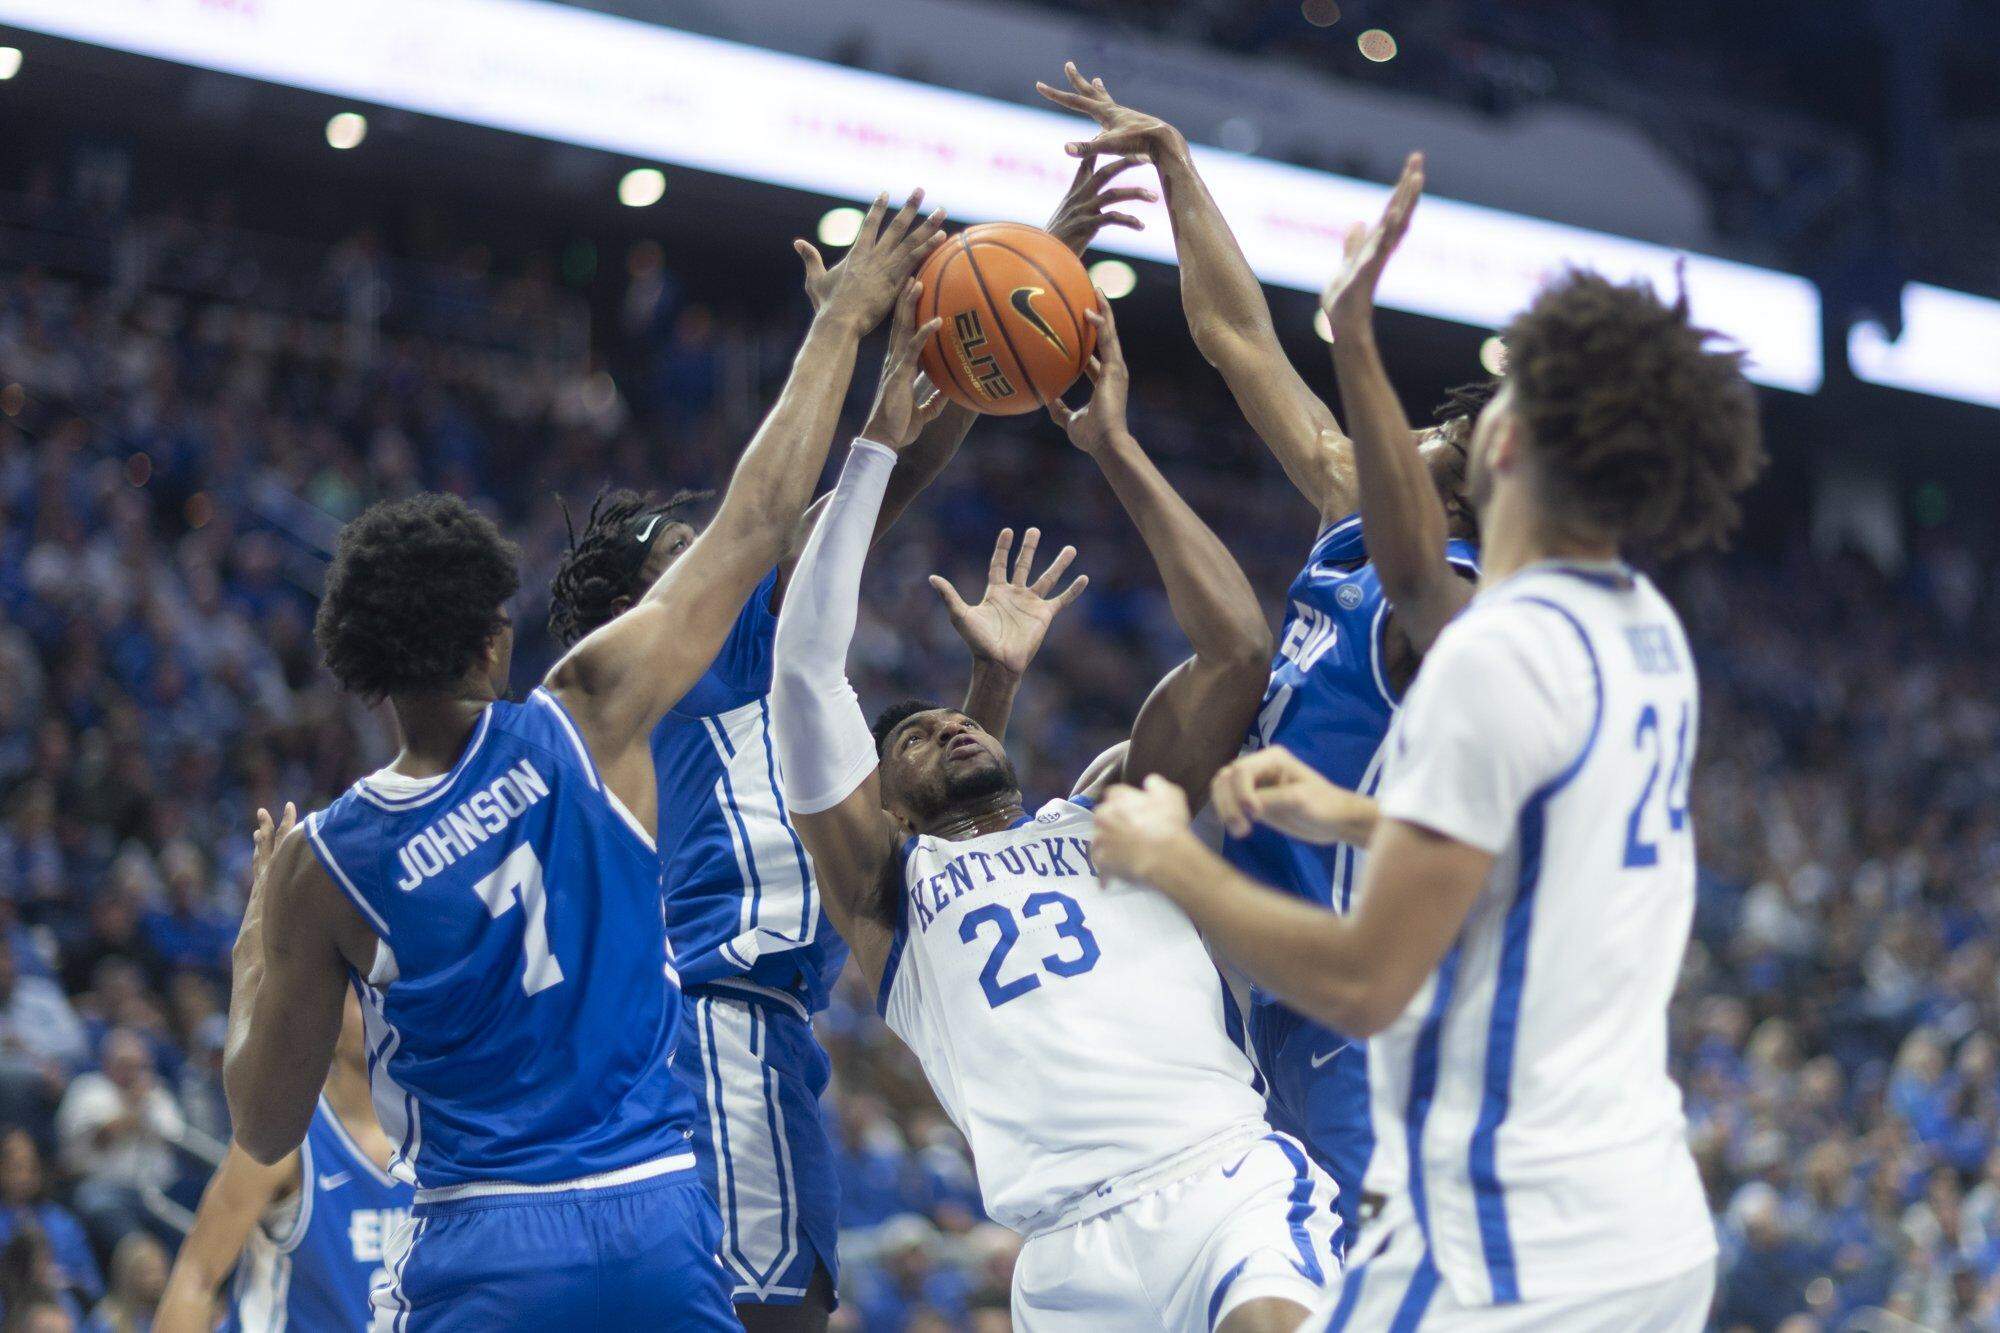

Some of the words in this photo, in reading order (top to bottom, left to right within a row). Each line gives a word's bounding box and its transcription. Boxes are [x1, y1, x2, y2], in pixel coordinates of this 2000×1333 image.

[954, 308, 1018, 400] ELITE
[1281, 600, 1338, 674] EIU
[398, 759, 550, 892] JOHNSON
[473, 841, 565, 998] 7
[911, 837, 1099, 934] KENTUCKY
[958, 891, 1102, 1009] 23
